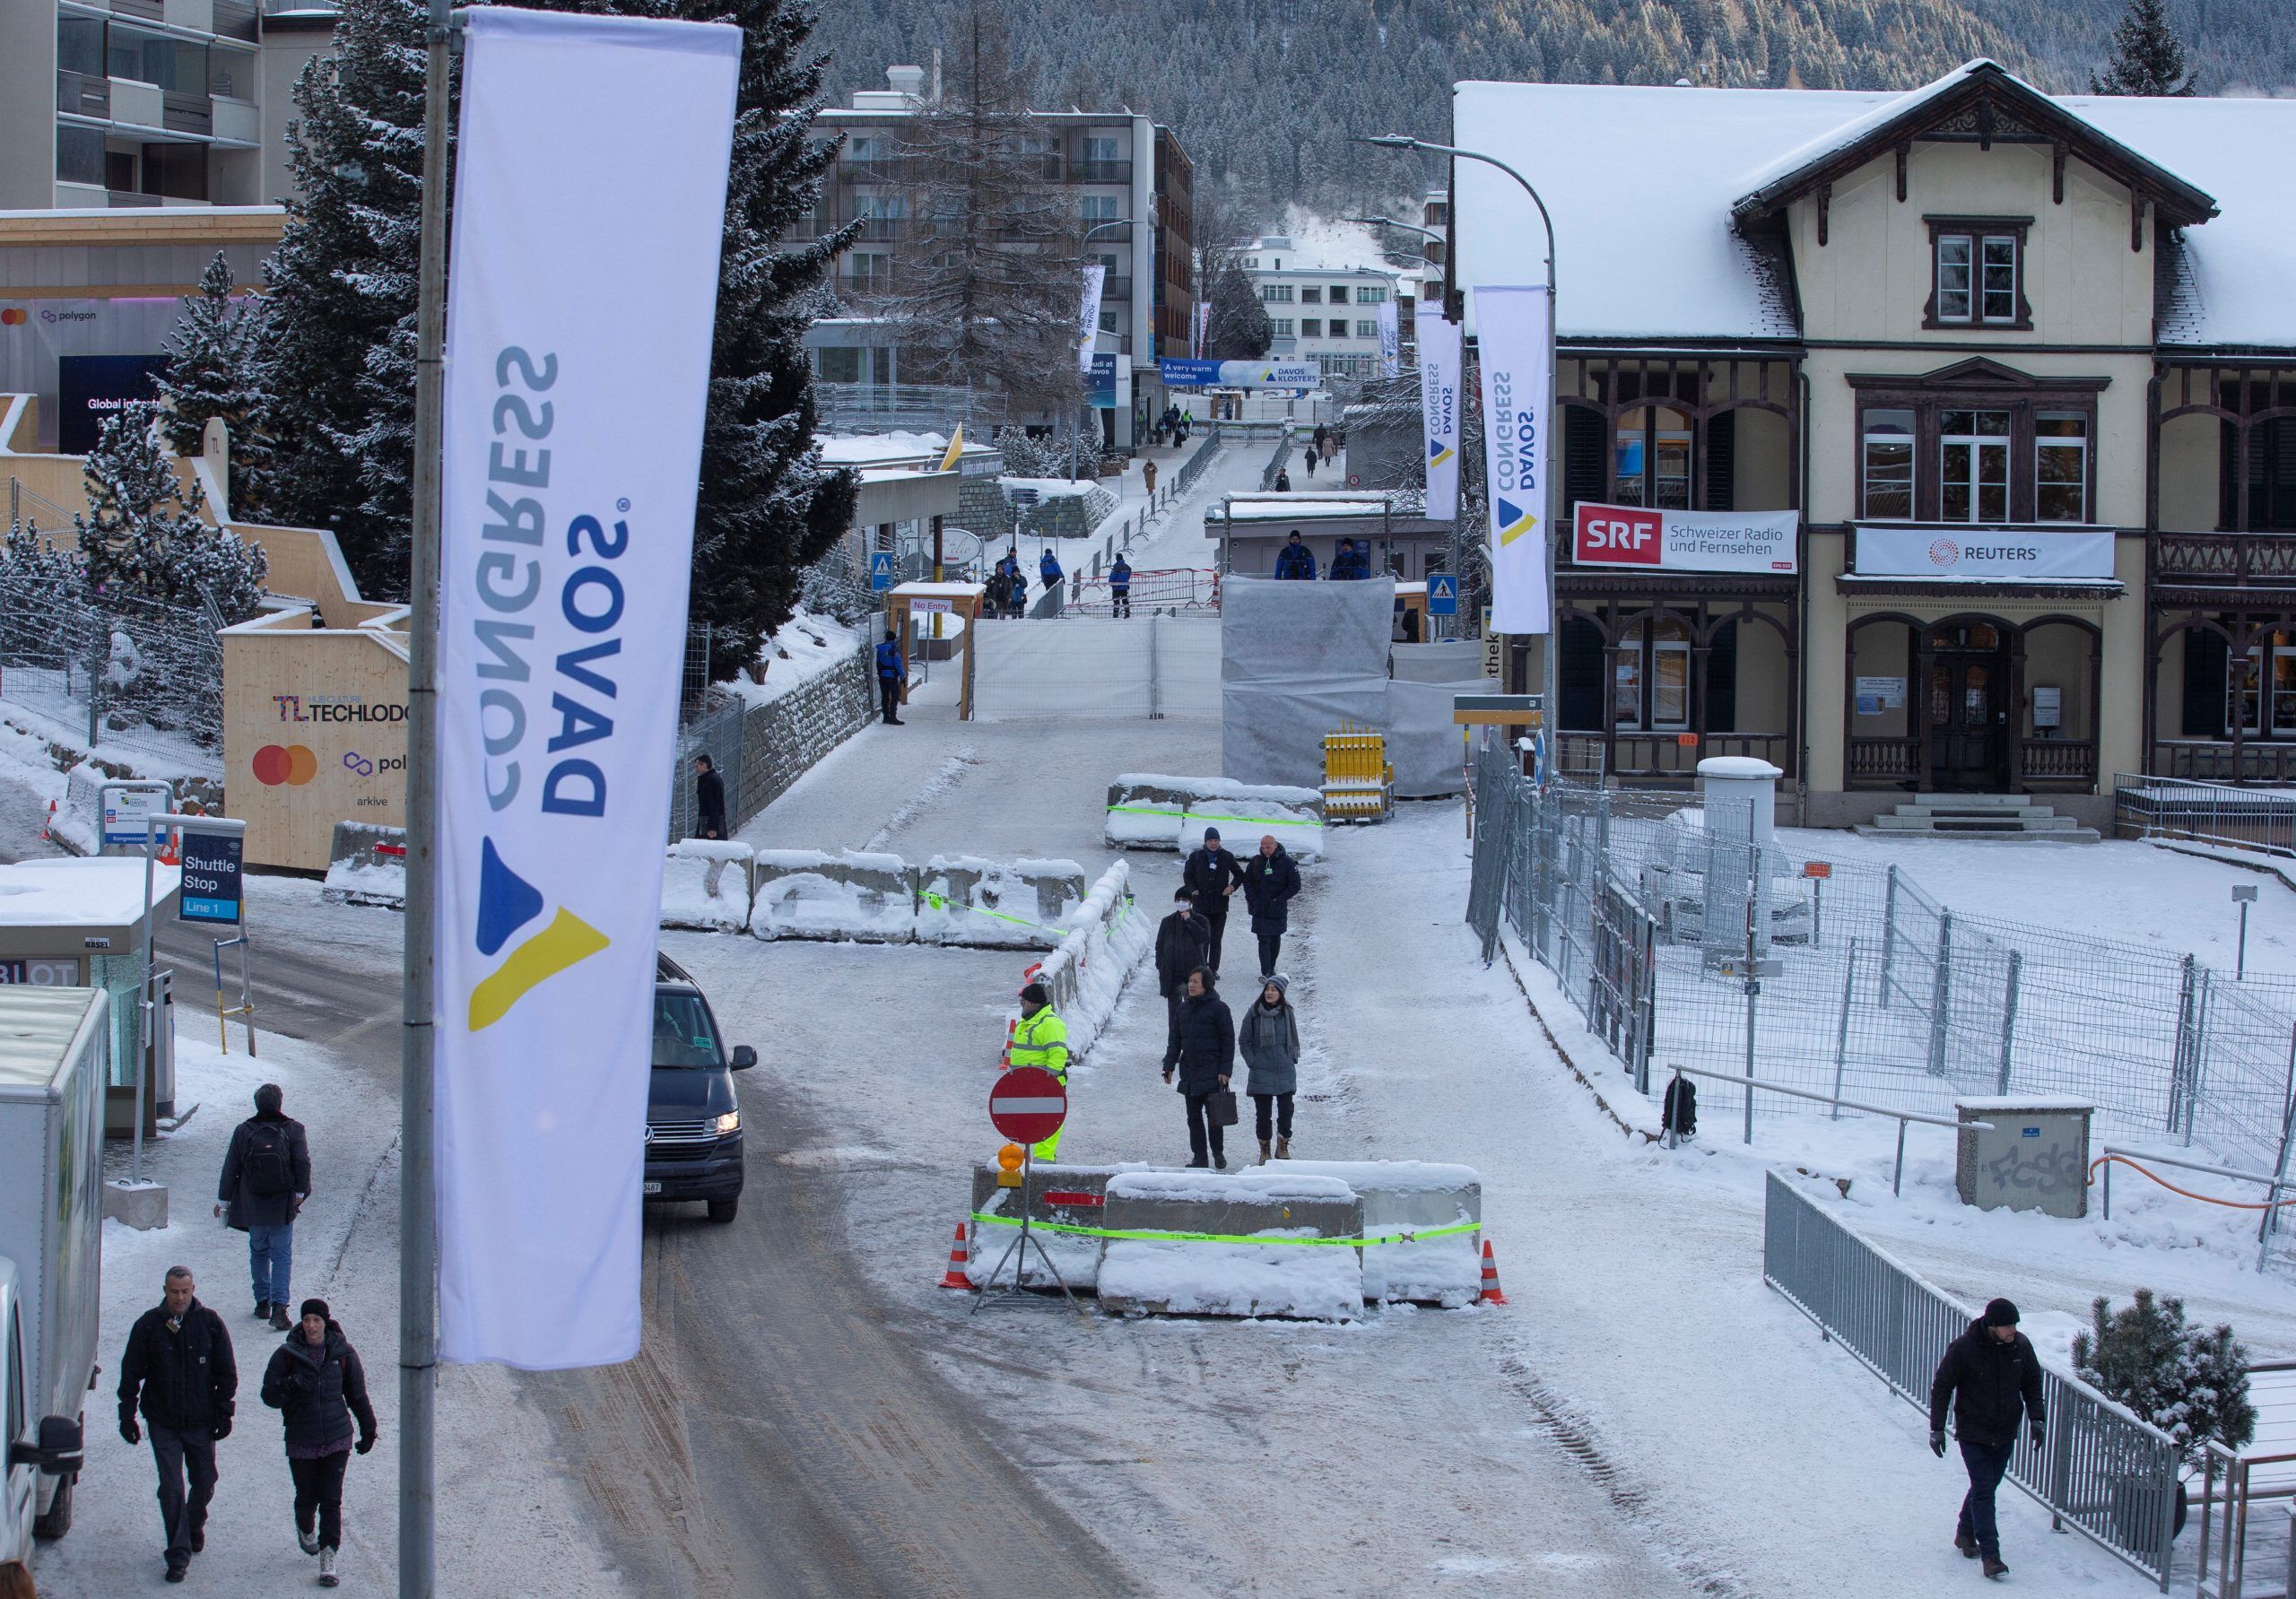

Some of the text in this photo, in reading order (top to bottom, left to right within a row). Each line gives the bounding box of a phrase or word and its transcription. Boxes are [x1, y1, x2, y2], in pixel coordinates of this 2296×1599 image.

[59, 311, 96, 321] polygon
[1173, 365, 1189, 373] very
[88, 398, 121, 409] Global
[1587, 520, 1653, 550] SRF
[1671, 526, 1783, 541] Schweizer Radio
[1670, 540, 1772, 555] und Fernsehen
[1965, 546, 2037, 561] REUTERS
[914, 601, 948, 610] No Entry
[1485, 634, 1499, 679] thek
[309, 695, 362, 703] HUB CULTURE
[309, 704, 410, 722] TECHLOD
[379, 754, 407, 773] pol
[357, 796, 388, 806] arkive
[185, 856, 236, 873] Shuttle
[184, 875, 218, 892] Stop
[187, 901, 218, 914] Line 1
[0, 964, 74, 986] BLOT
